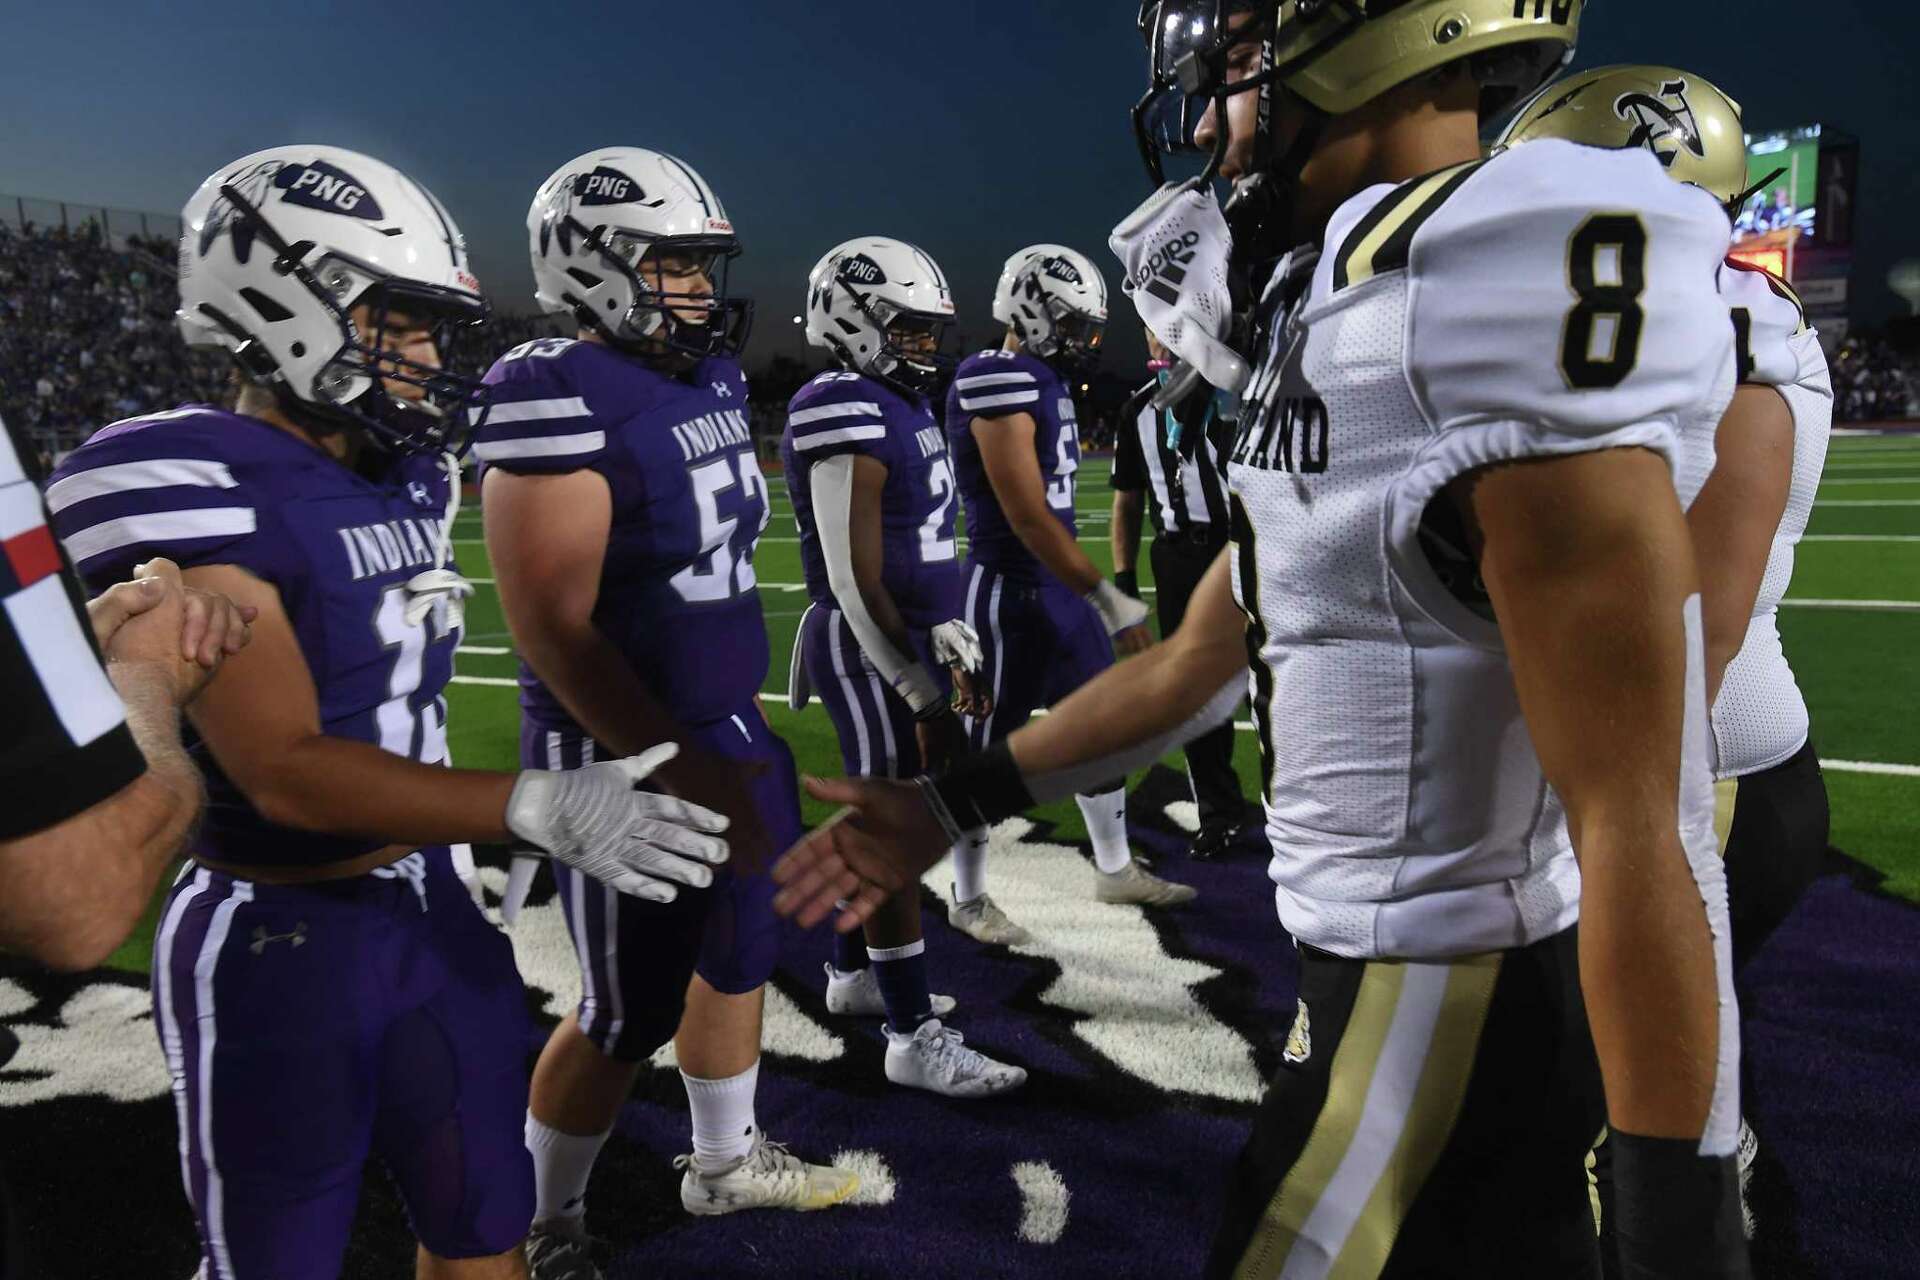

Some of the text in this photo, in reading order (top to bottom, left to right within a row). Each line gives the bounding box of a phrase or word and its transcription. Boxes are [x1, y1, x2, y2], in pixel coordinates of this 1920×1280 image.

[1258, 39, 1272, 135] XENTH
[290, 167, 366, 211] PNG
[583, 175, 631, 200] PNG
[845, 259, 876, 282] PNG
[1049, 260, 1079, 283] PNG
[1135, 230, 1199, 290] adidas
[1556, 210, 1648, 391] 8
[671, 408, 752, 462] INDIAN
[338, 518, 455, 580] INDIAN
